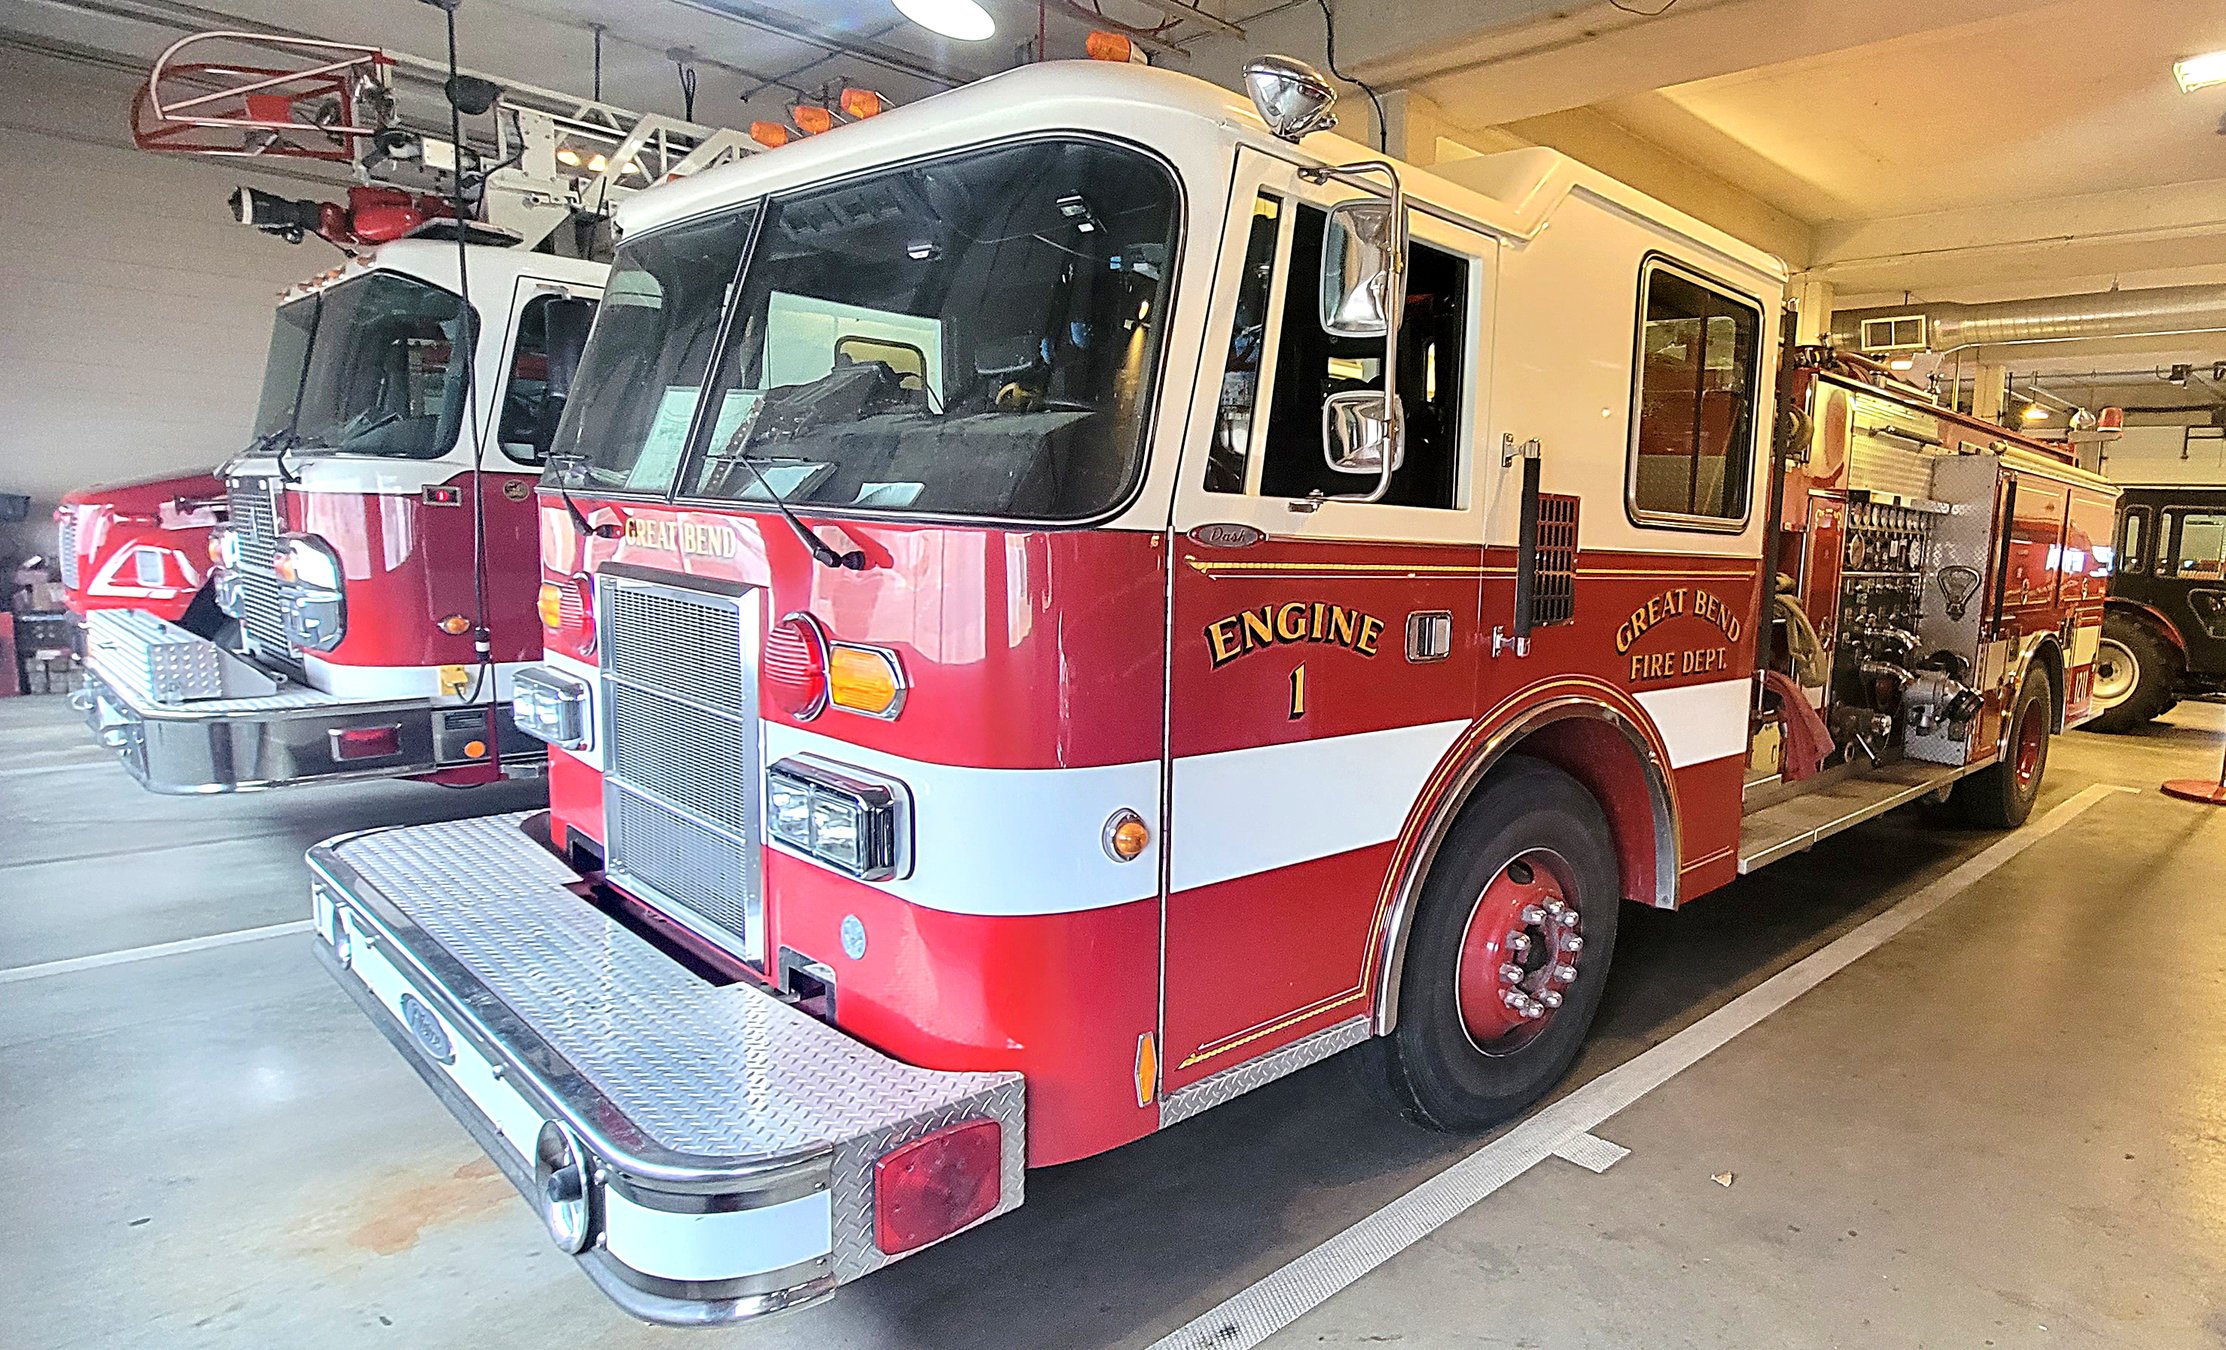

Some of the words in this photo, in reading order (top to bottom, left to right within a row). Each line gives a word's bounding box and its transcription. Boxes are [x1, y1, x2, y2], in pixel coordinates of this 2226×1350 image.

[624, 517, 677, 551] GREAT
[683, 523, 737, 558] BEND
[1209, 526, 1246, 542] Dash
[1204, 602, 1385, 670] ENGINE
[1616, 588, 1687, 655] GREAT
[1694, 589, 1740, 642] BEND
[1630, 651, 1676, 682] FIRE
[1682, 647, 1727, 674] DEPT.
[1289, 662, 1306, 720] 1
